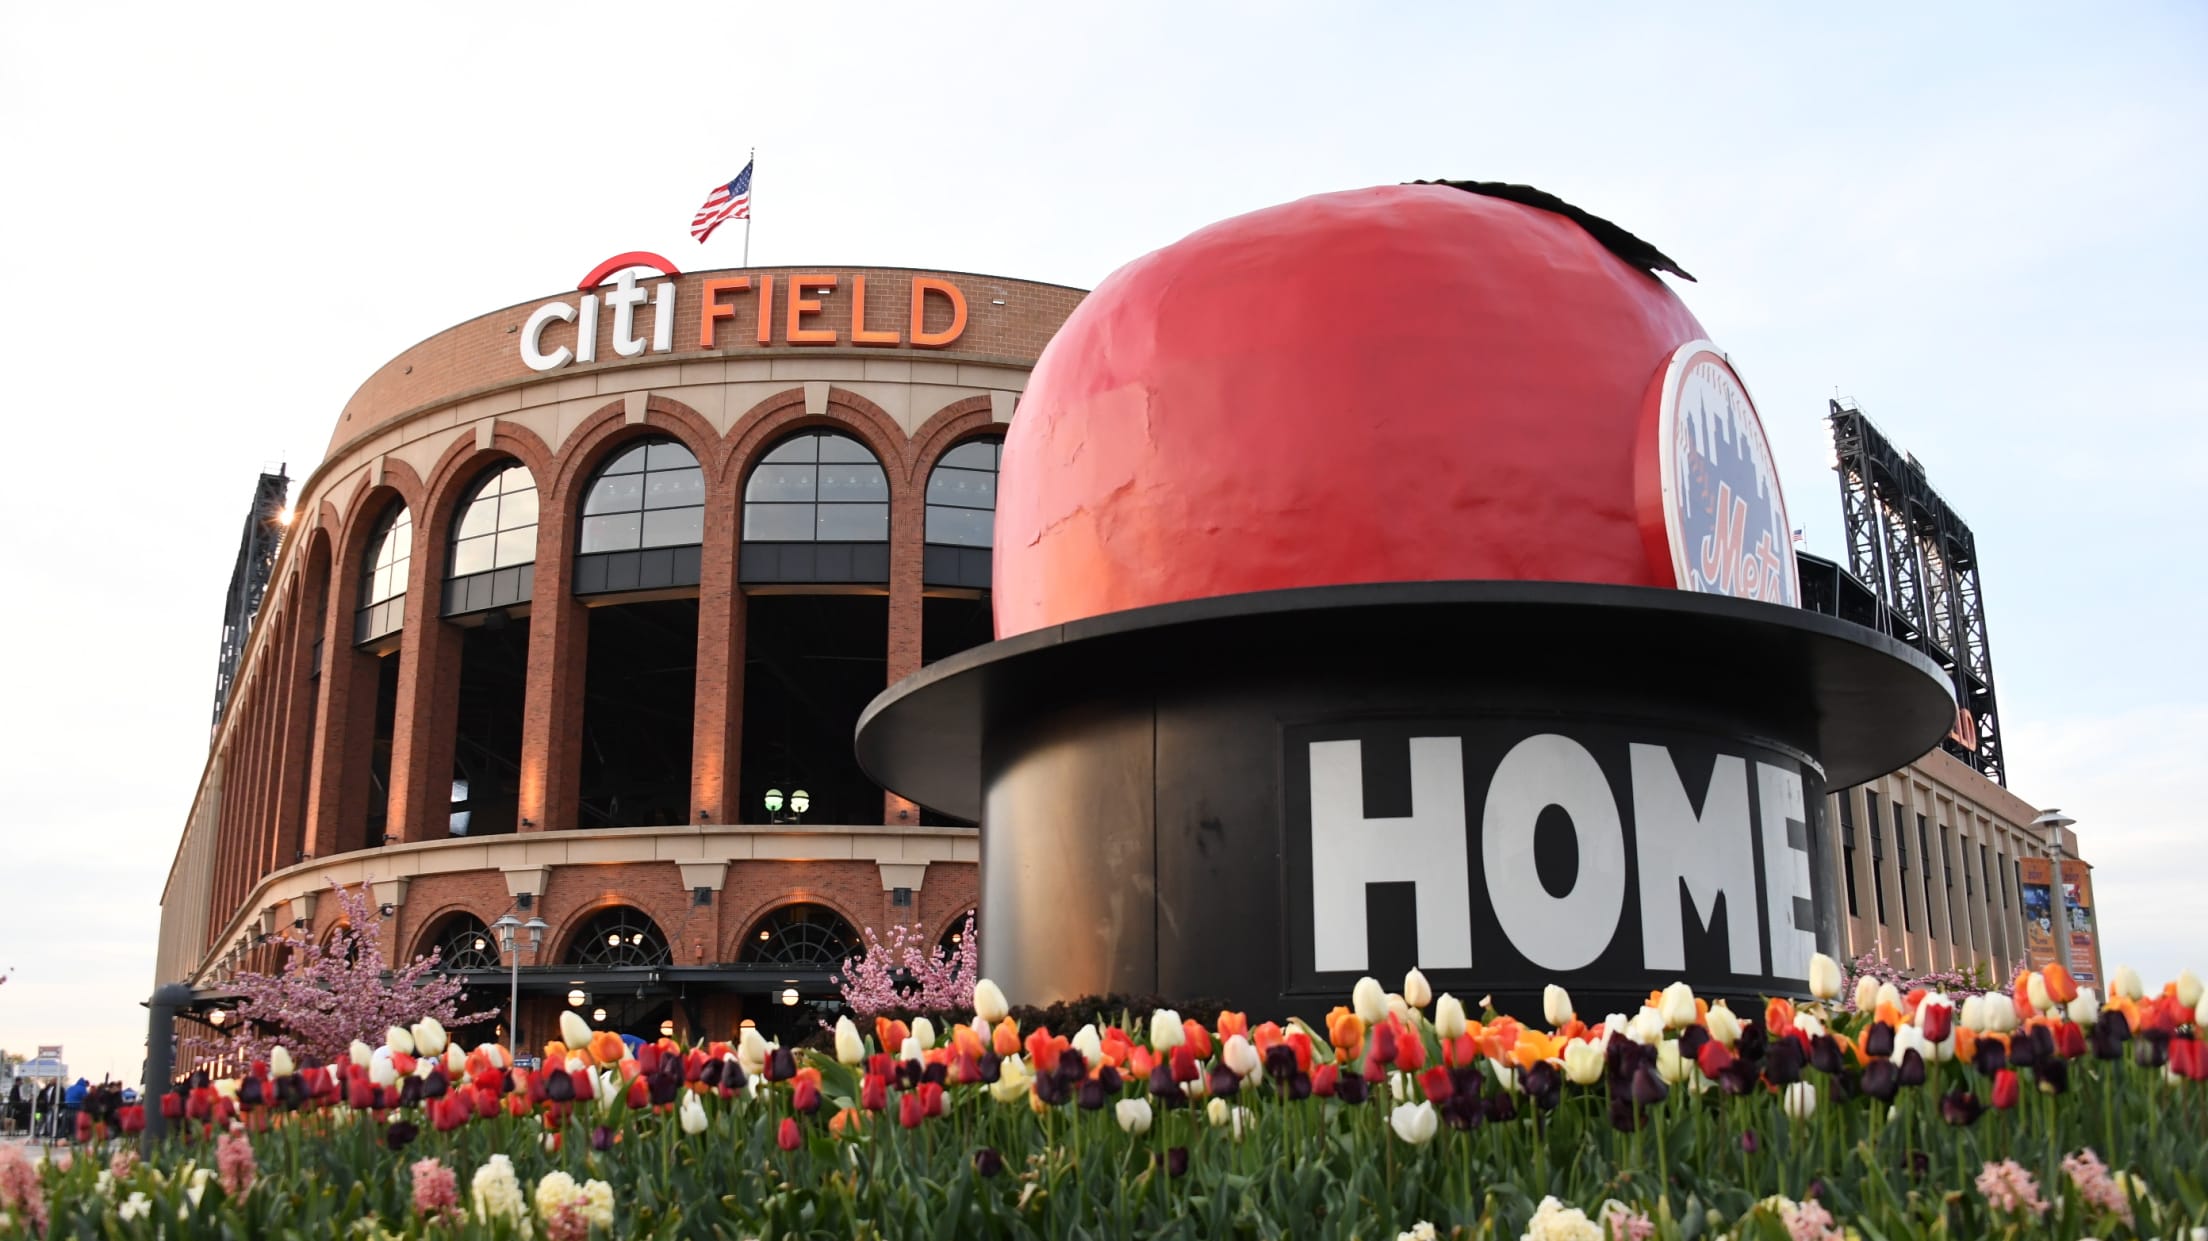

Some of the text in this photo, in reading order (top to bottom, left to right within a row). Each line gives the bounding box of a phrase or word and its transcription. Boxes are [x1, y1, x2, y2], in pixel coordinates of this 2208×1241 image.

[519, 269, 969, 372] citi FIELD
[1308, 733, 1818, 982] HOME
